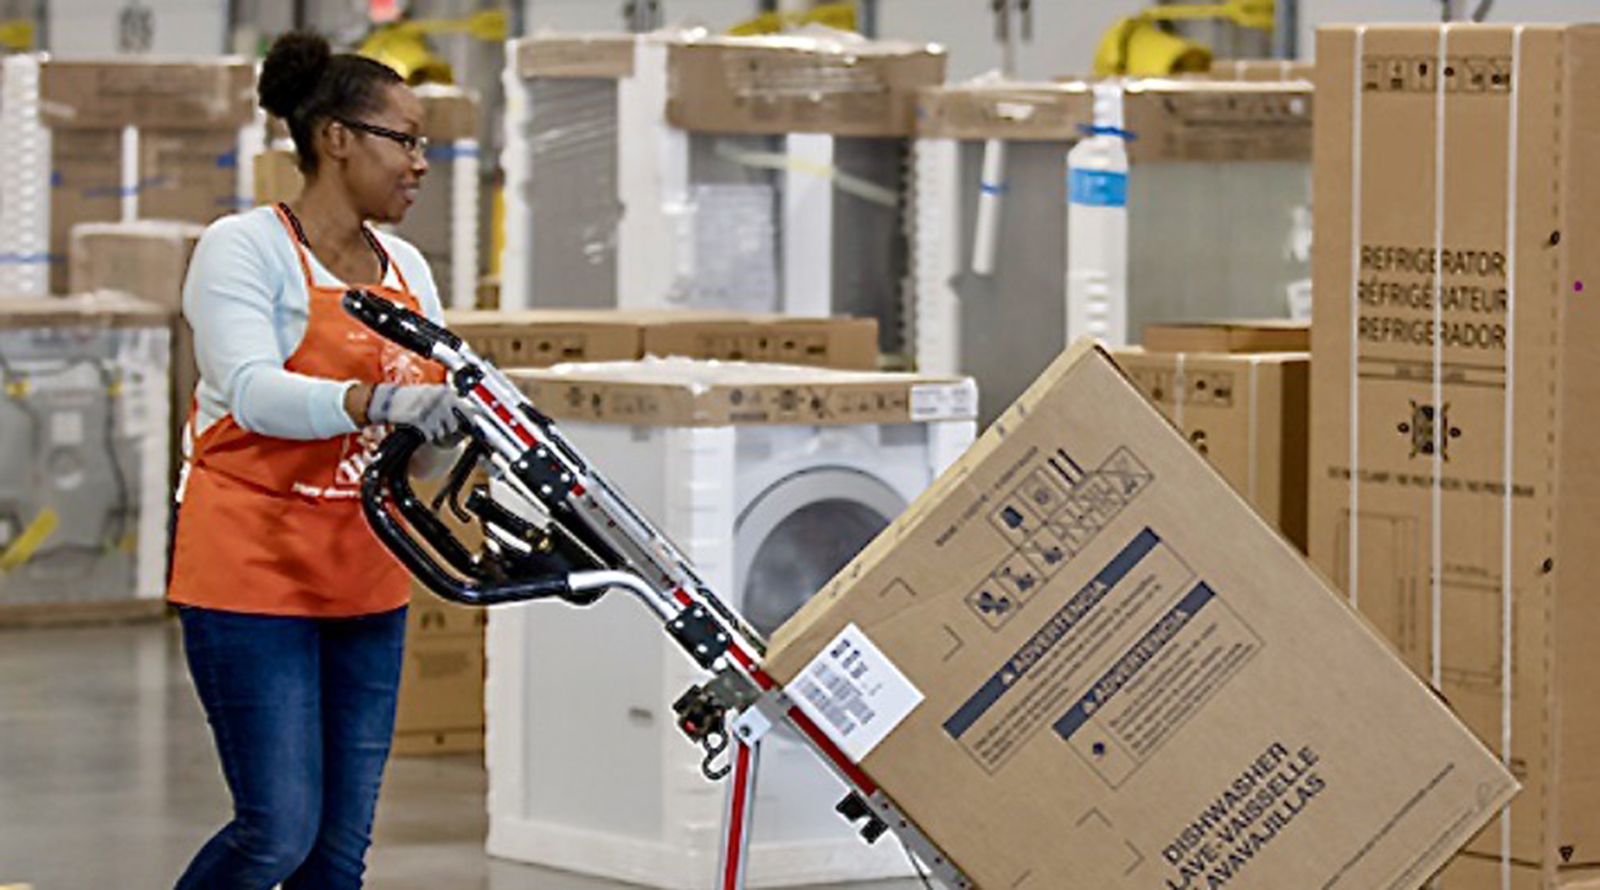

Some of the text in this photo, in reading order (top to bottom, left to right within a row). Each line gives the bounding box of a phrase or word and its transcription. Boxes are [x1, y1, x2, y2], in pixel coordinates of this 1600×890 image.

[1358, 275, 1507, 312] RÉFRIGÉRATEUR
[1361, 246, 1506, 277] REFRIGERATOR
[1358, 317, 1506, 350] REFRIGERADOR
[1012, 579, 1108, 677] ADVERTENCIA
[1093, 608, 1189, 705] ADVERTENCIA
[1162, 742, 1289, 866] DISHWASHER
[1193, 773, 1326, 890] AVAVAJILLAS
